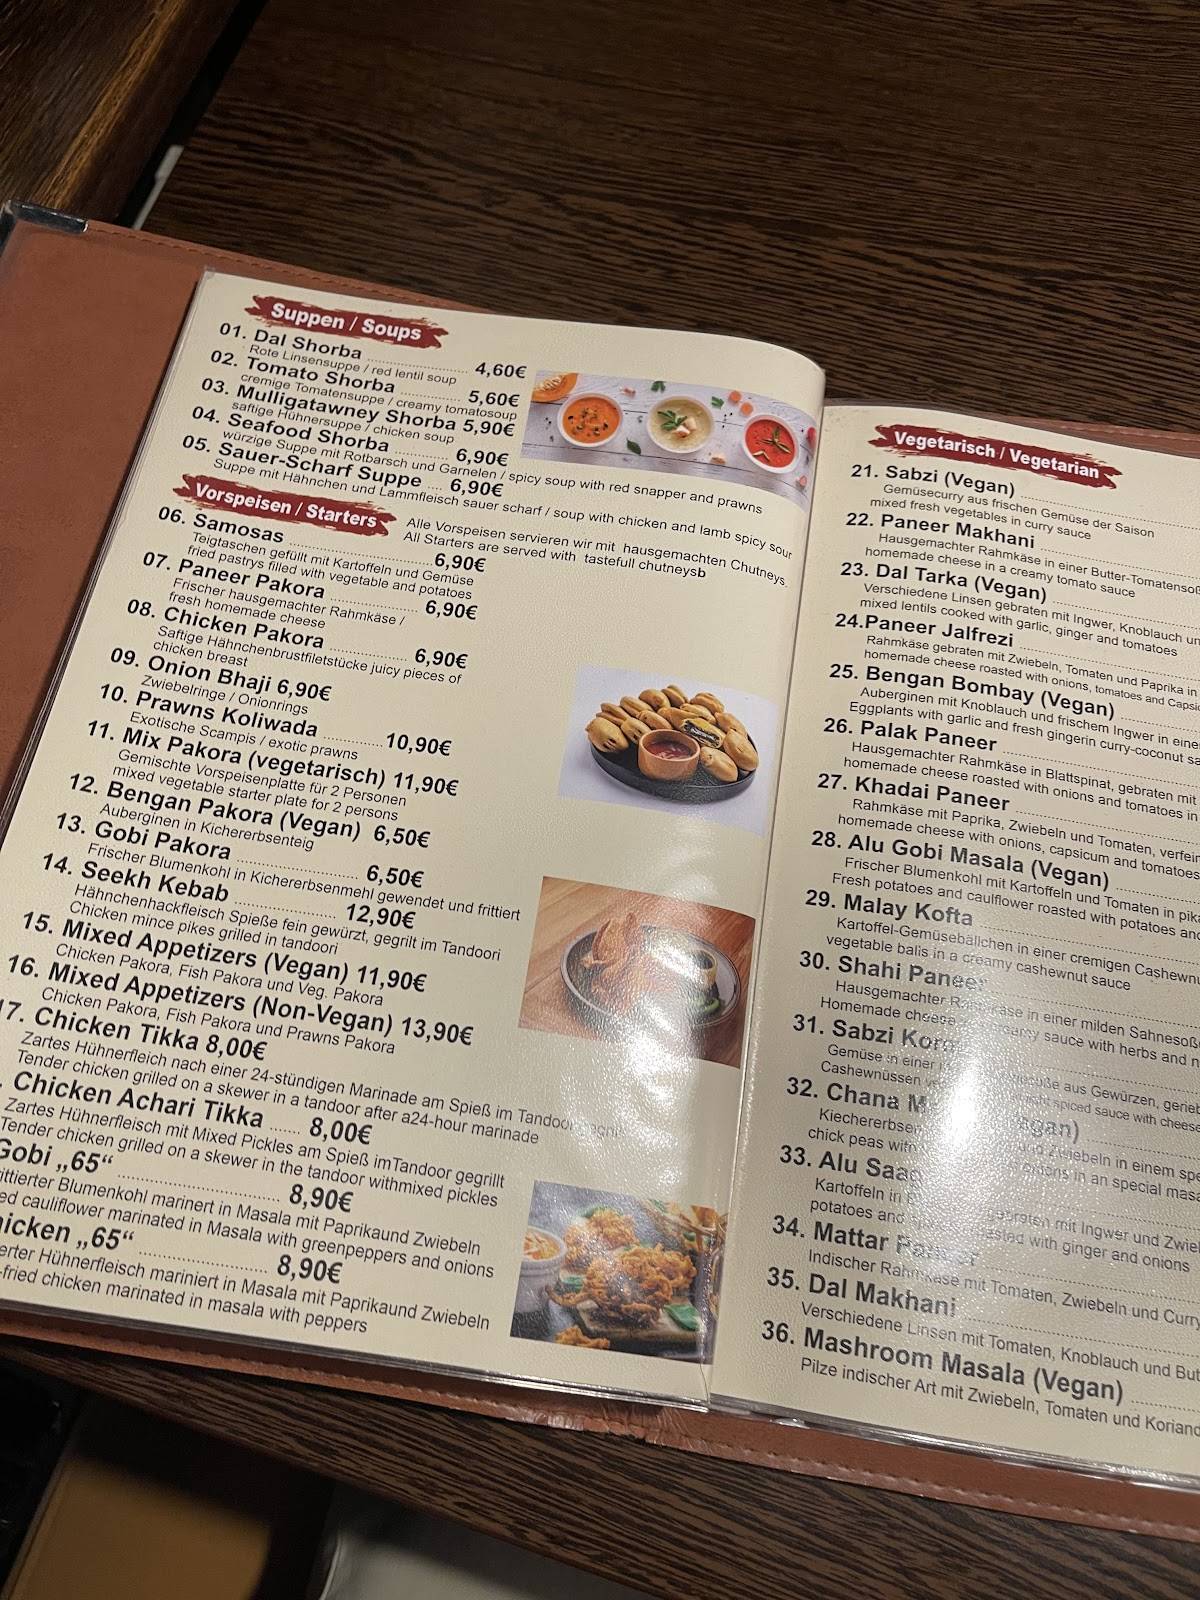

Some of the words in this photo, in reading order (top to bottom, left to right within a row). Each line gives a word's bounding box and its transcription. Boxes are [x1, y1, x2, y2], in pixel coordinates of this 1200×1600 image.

[271, 303, 345, 329] Suppen
[362, 318, 422, 341] Soups
[220, 322, 246, 339] 01.
[254, 329, 287, 347] Dal
[292, 336, 362, 360] Shorba
[475, 362, 527, 379] 4,60€
[250, 344, 279, 358] Rote
[282, 350, 361, 373] Linsensuppe
[371, 367, 392, 376] red
[395, 369, 424, 381] lentil
[427, 374, 457, 386] soup
[202, 378, 229, 395] 03.
[236, 384, 380, 424] Mulligatawney
[385, 409, 457, 431] Shorba
[462, 418, 516, 437] 5,90€
[241, 374, 291, 390] cremige
[295, 382, 385, 406] Tomatensuppe
[396, 400, 442, 414] creamy
[445, 404, 517, 422] tomatosoup
[182, 435, 211, 453] 05.
[218, 442, 355, 478] Sauer-Scharf
[357, 466, 422, 489] Suppe
[450, 478, 504, 498] 6,90€
[851, 464, 878, 478] 21.
[885, 465, 938, 483] Sabzi
[944, 471, 1015, 499] (Vegan)
[895, 431, 995, 458] Vegetarisch
[1010, 448, 1099, 479] Vegetarian
[197, 483, 292, 514] Vorspeisen
[306, 504, 377, 528] Starters
[846, 512, 874, 527] 22.
[881, 514, 950, 534] Paneer
[956, 522, 1035, 549] Makhani
[884, 484, 965, 504] Gemüsecurry
[967, 496, 989, 506] aus
[992, 498, 1037, 516] frischen
[1041, 508, 1090, 526] Gemüse
[1092, 519, 1112, 530] der
[1115, 522, 1155, 538] Saison
[158, 506, 186, 524] 06.
[193, 513, 284, 543] Samosas
[434, 552, 487, 573] 6,90€
[403, 531, 421, 543] All
[424, 533, 474, 551] Starters
[478, 543, 500, 553] are
[503, 546, 547, 558] served
[550, 550, 576, 562] with
[584, 553, 636, 569] tastefull
[638, 560, 706, 578] chutneysb
[406, 518, 431, 530] Alle
[436, 521, 506, 540] Vorspeisen
[509, 532, 569, 547] servieren
[573, 538, 593, 549] wir
[595, 541, 616, 552] mit
[623, 543, 727, 568] hausgemachten
[730, 559, 788, 587] Chutneys.
[188, 545, 217, 560] fried
[218, 553, 265, 570] pastrys
[268, 560, 298, 575] filled
[300, 567, 325, 580] with
[330, 572, 389, 589] vegetable
[392, 582, 417, 593] and
[418, 585, 472, 600] potatoes
[865, 547, 934, 562] homemade
[938, 554, 982, 569] cheese
[985, 560, 996, 572] in
[999, 565, 1007, 573] a
[1010, 567, 1054, 584] creamy
[1057, 574, 1097, 591] tomato
[1100, 584, 1136, 598] sauce
[835, 613, 937, 635] 24.Paneer
[942, 623, 1014, 647] Jalfrezi
[110, 648, 139, 668] 09.
[148, 655, 211, 682] Onion
[217, 668, 272, 695] Bhaji
[277, 679, 332, 702] 6,90€
[141, 674, 226, 702] Zwiebelringe
[238, 693, 309, 716] Onionrings
[88, 720, 114, 741] 11.
[122, 726, 162, 750] Mix
[166, 735, 242, 764] Pakora
[248, 750, 386, 790] (vegetarisch)
[394, 772, 459, 797] 11,90€
[823, 718, 853, 734] 26.
[860, 720, 918, 741] Palak
[925, 726, 998, 751] Paneer
[70, 773, 98, 795] 12.
[106, 780, 192, 813] Bengan
[198, 797, 273, 826] Pakora
[280, 810, 361, 843] (Vegan)
[374, 824, 431, 848] 6,50€
[100, 803, 180, 829] Auberginen
[184, 818, 197, 832] in
[200, 821, 315, 852] Kichererbsenteig
[811, 830, 842, 848] 28.
[848, 834, 884, 853] Alu
[892, 839, 943, 861] Gobi
[950, 846, 1024, 874] Masala
[1031, 859, 1109, 892] (Vegan)
[43, 852, 72, 875] 14.
[81, 860, 151, 890] Seekh
[158, 874, 229, 902] Kebab
[347, 903, 417, 930] 12,90€
[805, 889, 836, 909] 29.
[844, 893, 908, 921] Malay
[915, 902, 973, 926] Kofta
[70, 900, 128, 923] Chicken
[132, 914, 175, 930] mince
[177, 920, 215, 937] pikes
[218, 927, 262, 944] grilled
[264, 932, 277, 947] in
[281, 935, 339, 955] tandoori
[826, 936, 893, 953] vegetable
[933, 949, 945, 960] in
[950, 952, 958, 962] a
[962, 952, 1013, 972] creamy
[1016, 961, 1088, 984] cashewnut
[1091, 976, 1131, 991] sauce
[8, 954, 39, 978] 16.
[48, 961, 121, 992] Mixed
[122, 975, 246, 1011] Appetizers
[253, 995, 393, 1038] (Non-Vegan)
[402, 1017, 474, 1046] 13,90€
[14, 1071, 112, 1105] Chicken
[116, 1088, 196, 1118] Achari
[204, 1099, 264, 1128] Tikka
[310, 1116, 373, 1145] 8,00€
[780, 1144, 812, 1167] 33.
[818, 1150, 858, 1174] Alu
[289, 1183, 354, 1213] 8,90€
[42, 1272, 101, 1294] chicken
[106, 1284, 186, 1306] marinated
[189, 1292, 203, 1309] in
[208, 1298, 264, 1318] masala
[270, 1306, 300, 1323] with
[304, 1313, 368, 1333] peppers
[767, 1266, 800, 1291] 35.
[809, 1272, 847, 1299] Dal
[856, 1280, 957, 1318] Makhani
[761, 1320, 795, 1345] 36.
[804, 1326, 933, 1370] Mashroom
[942, 1351, 1025, 1386] Masala
[1034, 1367, 1123, 1407] (Vegan)
[801, 1357, 838, 1377] Pilze
[842, 1364, 912, 1390] indischer
[914, 1378, 937, 1395] Art
[941, 1384, 964, 1400] mit
[968, 1387, 1039, 1415] Zwiebeln,
[1044, 1400, 1108, 1423] Tomaten
[1113, 1414, 1140, 1428] und
